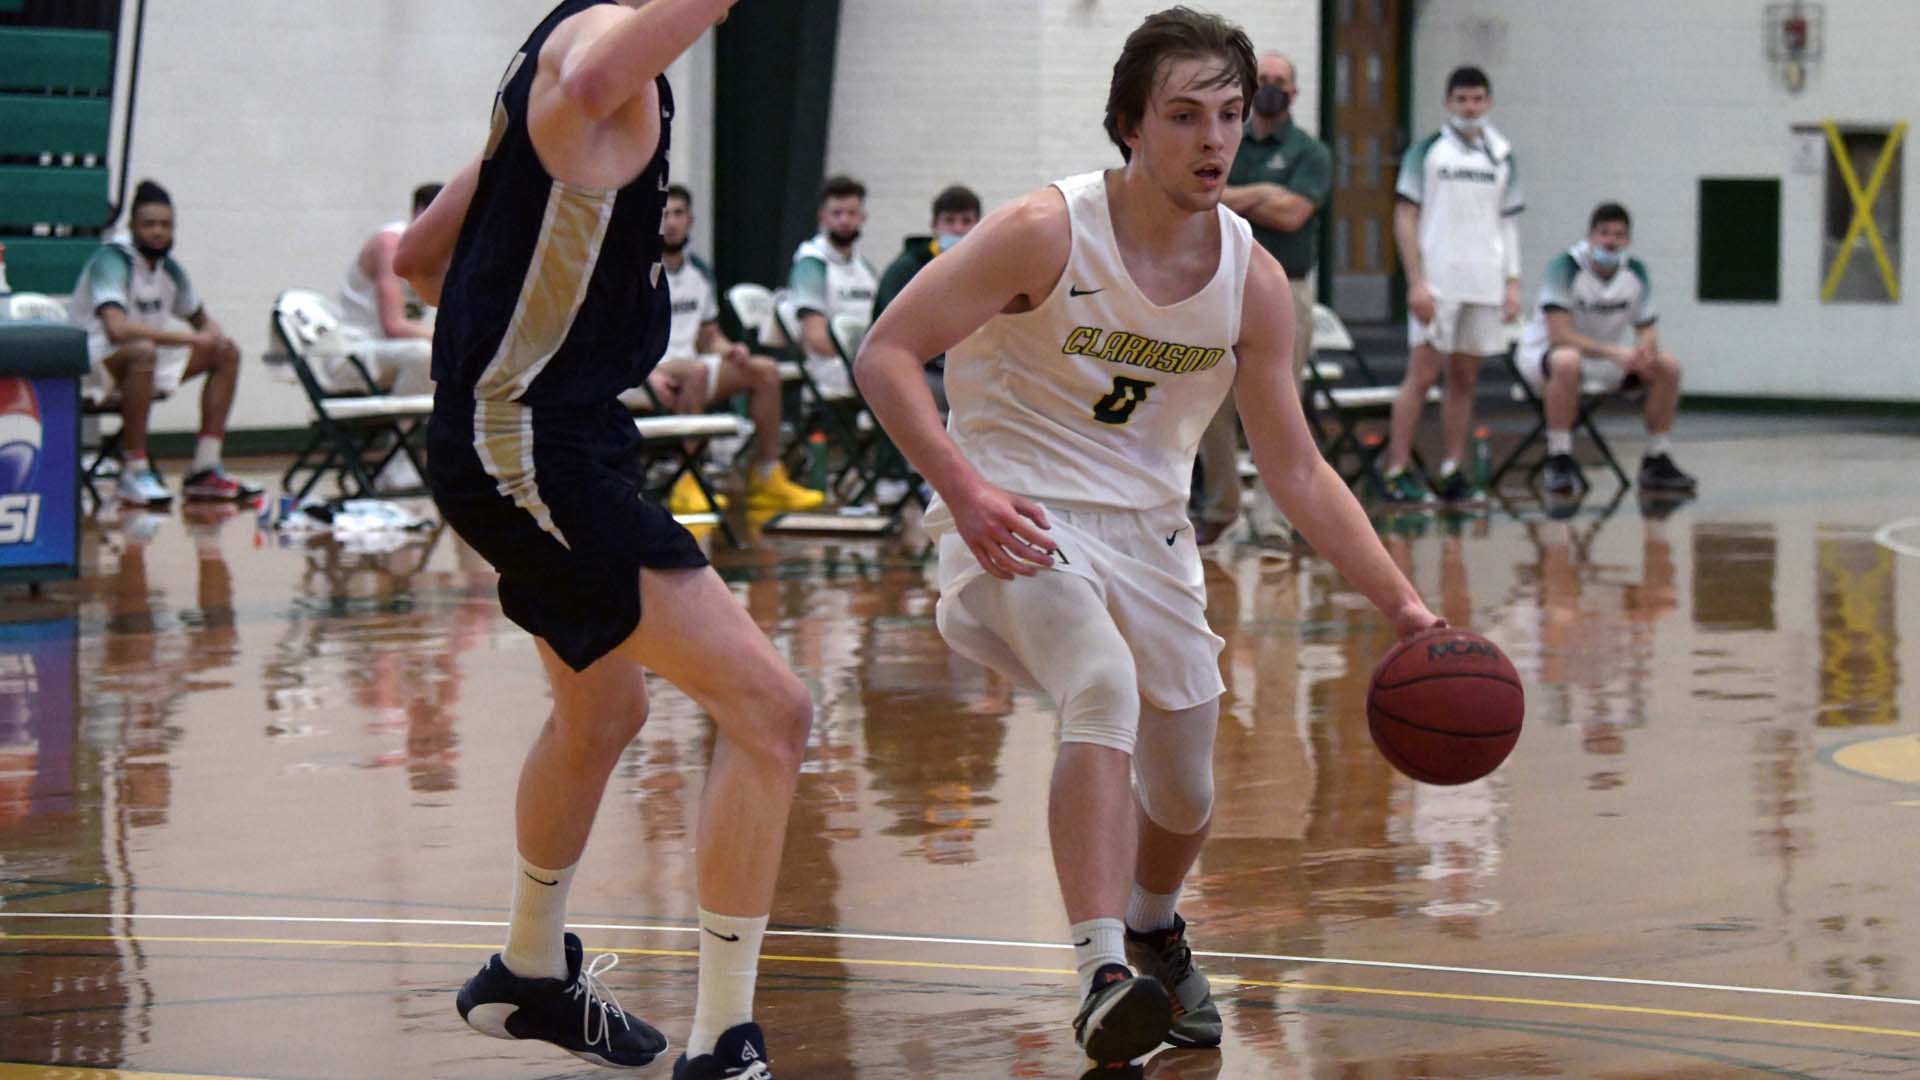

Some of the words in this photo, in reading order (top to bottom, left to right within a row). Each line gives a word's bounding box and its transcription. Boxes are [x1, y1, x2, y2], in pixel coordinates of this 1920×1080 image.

[1062, 326, 1225, 374] CLARKSON
[1093, 375, 1157, 425] 0
[1427, 640, 1499, 662] NCAA
